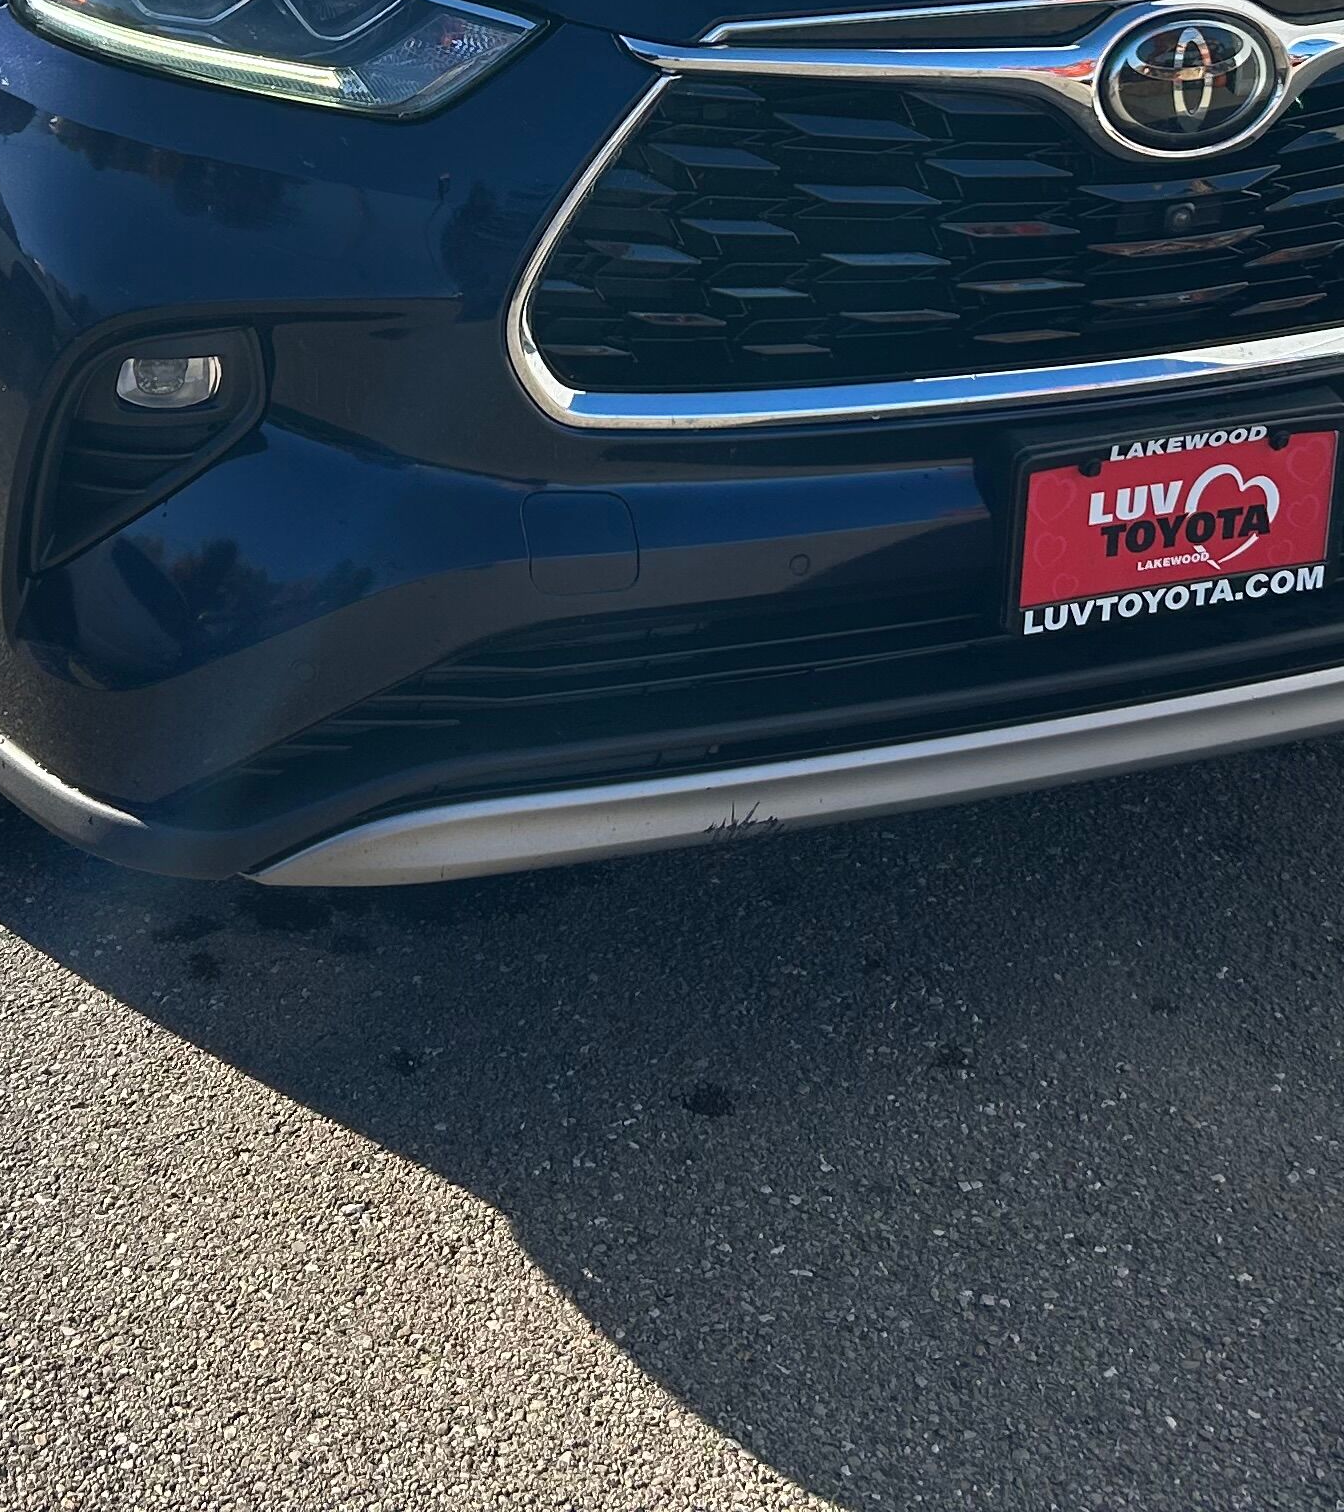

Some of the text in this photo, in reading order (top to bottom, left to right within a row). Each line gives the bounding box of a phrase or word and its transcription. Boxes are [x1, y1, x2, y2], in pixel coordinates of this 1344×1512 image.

[1109, 425, 1268, 462] LAKEWOOD
[1088, 479, 1184, 526] LUV
[1101, 504, 1271, 558] TOYOTA
[1137, 551, 1211, 572] LAKEWOOD
[1023, 565, 1326, 635] LUVTOYOTA.COM
